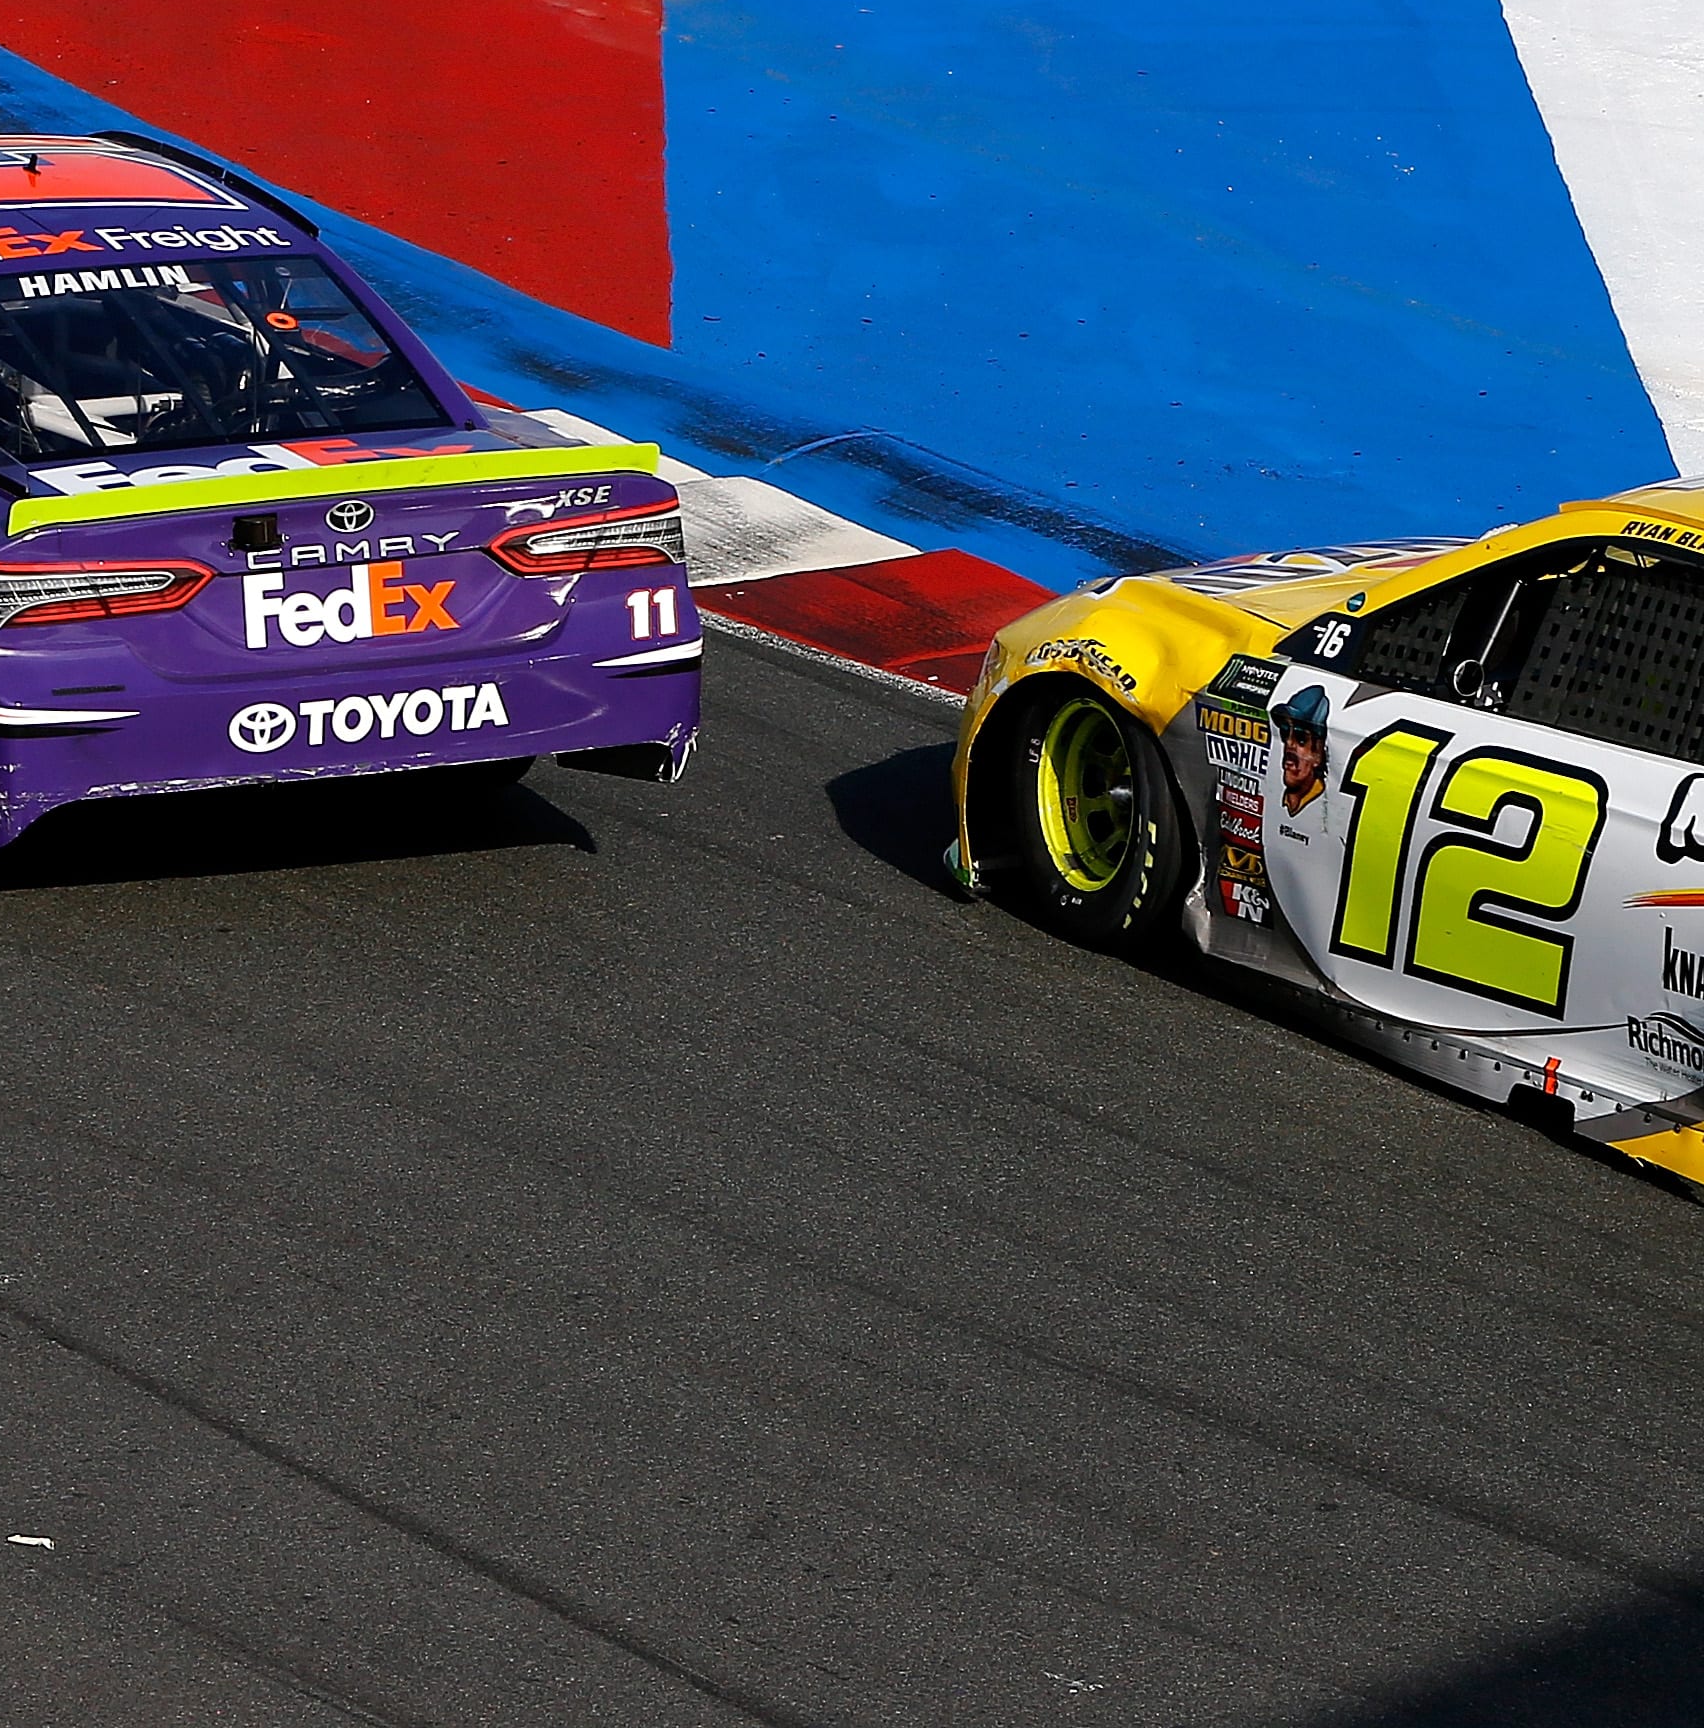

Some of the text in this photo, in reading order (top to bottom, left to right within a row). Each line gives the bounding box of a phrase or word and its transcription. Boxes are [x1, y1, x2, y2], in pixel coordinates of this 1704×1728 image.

[96, 225, 291, 252] Freight
[19, 265, 191, 298] HAMLIN
[557, 486, 611, 509] XSE
[1620, 521, 1677, 541] RYAN
[248, 532, 460, 569] CAMRY
[243, 561, 461, 648] FedEx
[626, 587, 680, 640] 11
[300, 682, 509, 745] TOYOTA
[1199, 707, 1269, 744] MOOG
[1208, 735, 1270, 776] MAHLE
[1220, 769, 1257, 795] LINCOLN
[1225, 790, 1259, 811] WELDERS
[1329, 719, 1609, 1021] 12
